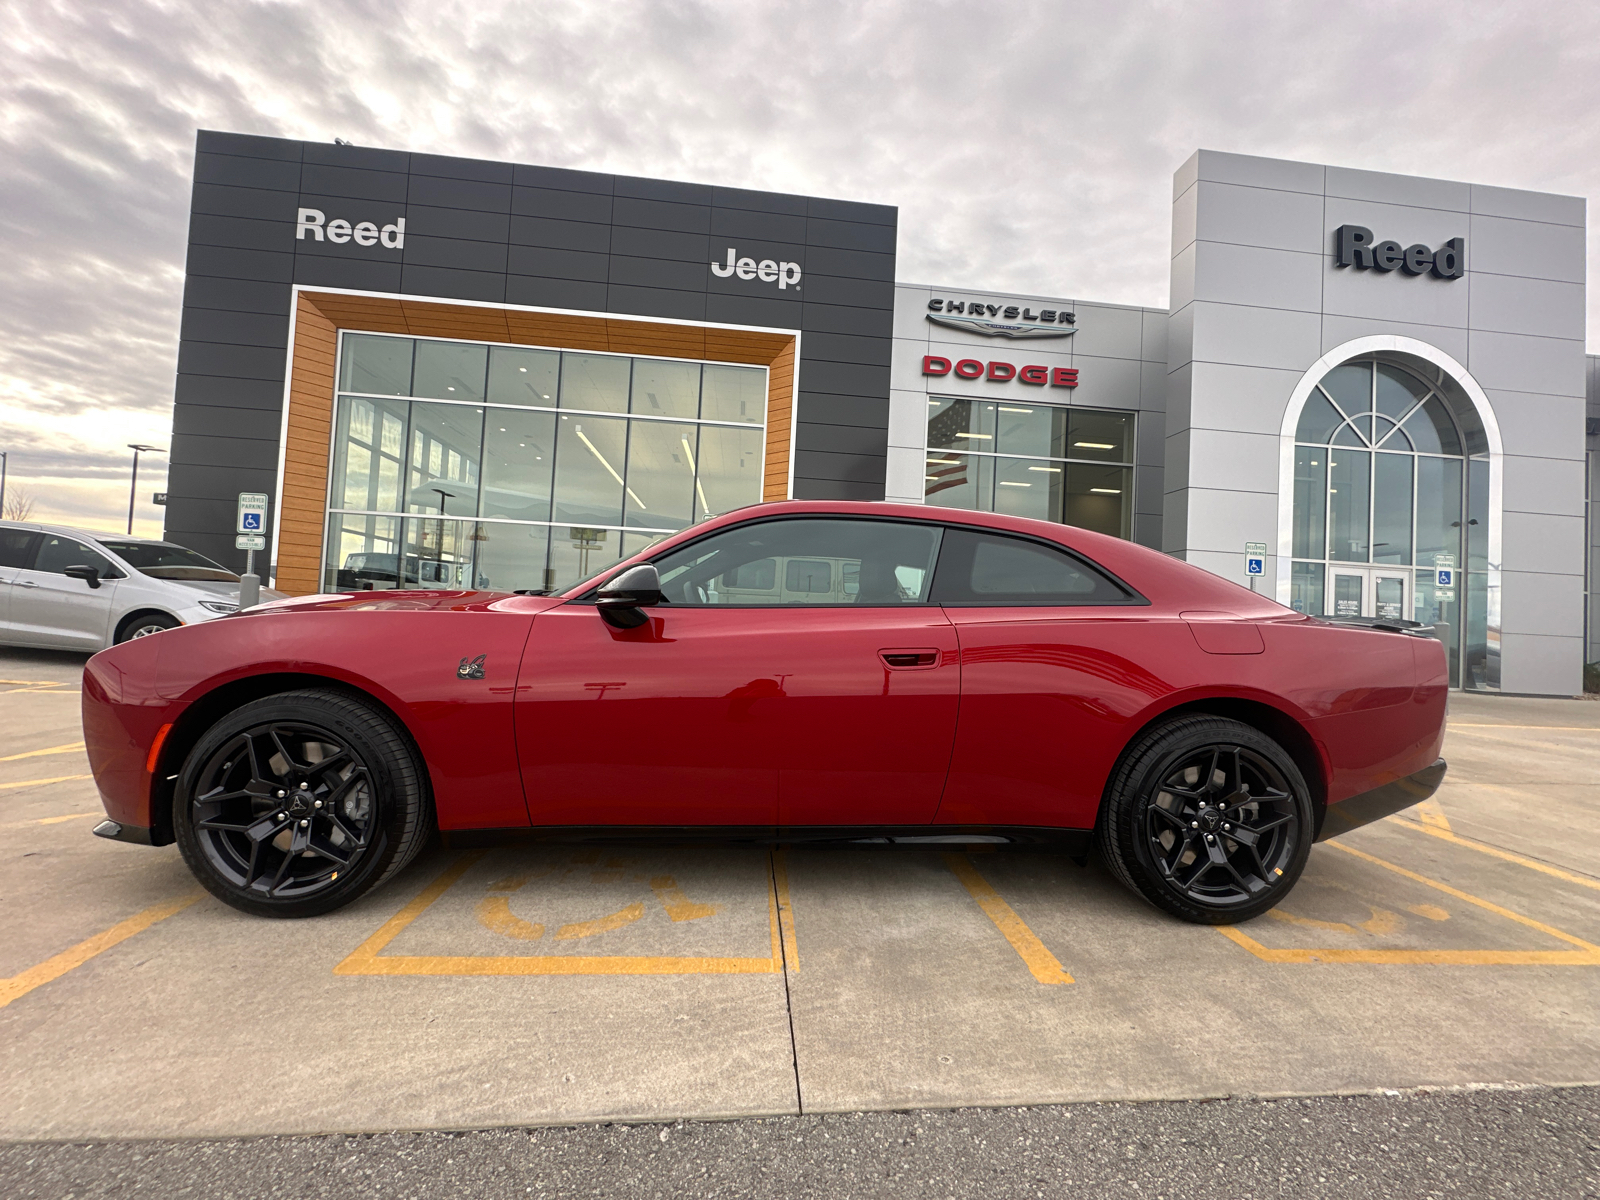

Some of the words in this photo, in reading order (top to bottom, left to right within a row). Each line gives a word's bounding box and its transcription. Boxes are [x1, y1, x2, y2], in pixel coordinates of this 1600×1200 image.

[296, 207, 406, 250] Reed
[711, 248, 802, 290] Jeep
[1336, 224, 1465, 279] Reed
[928, 298, 1077, 324] CHRYSLER
[922, 355, 1080, 388] DODGE
